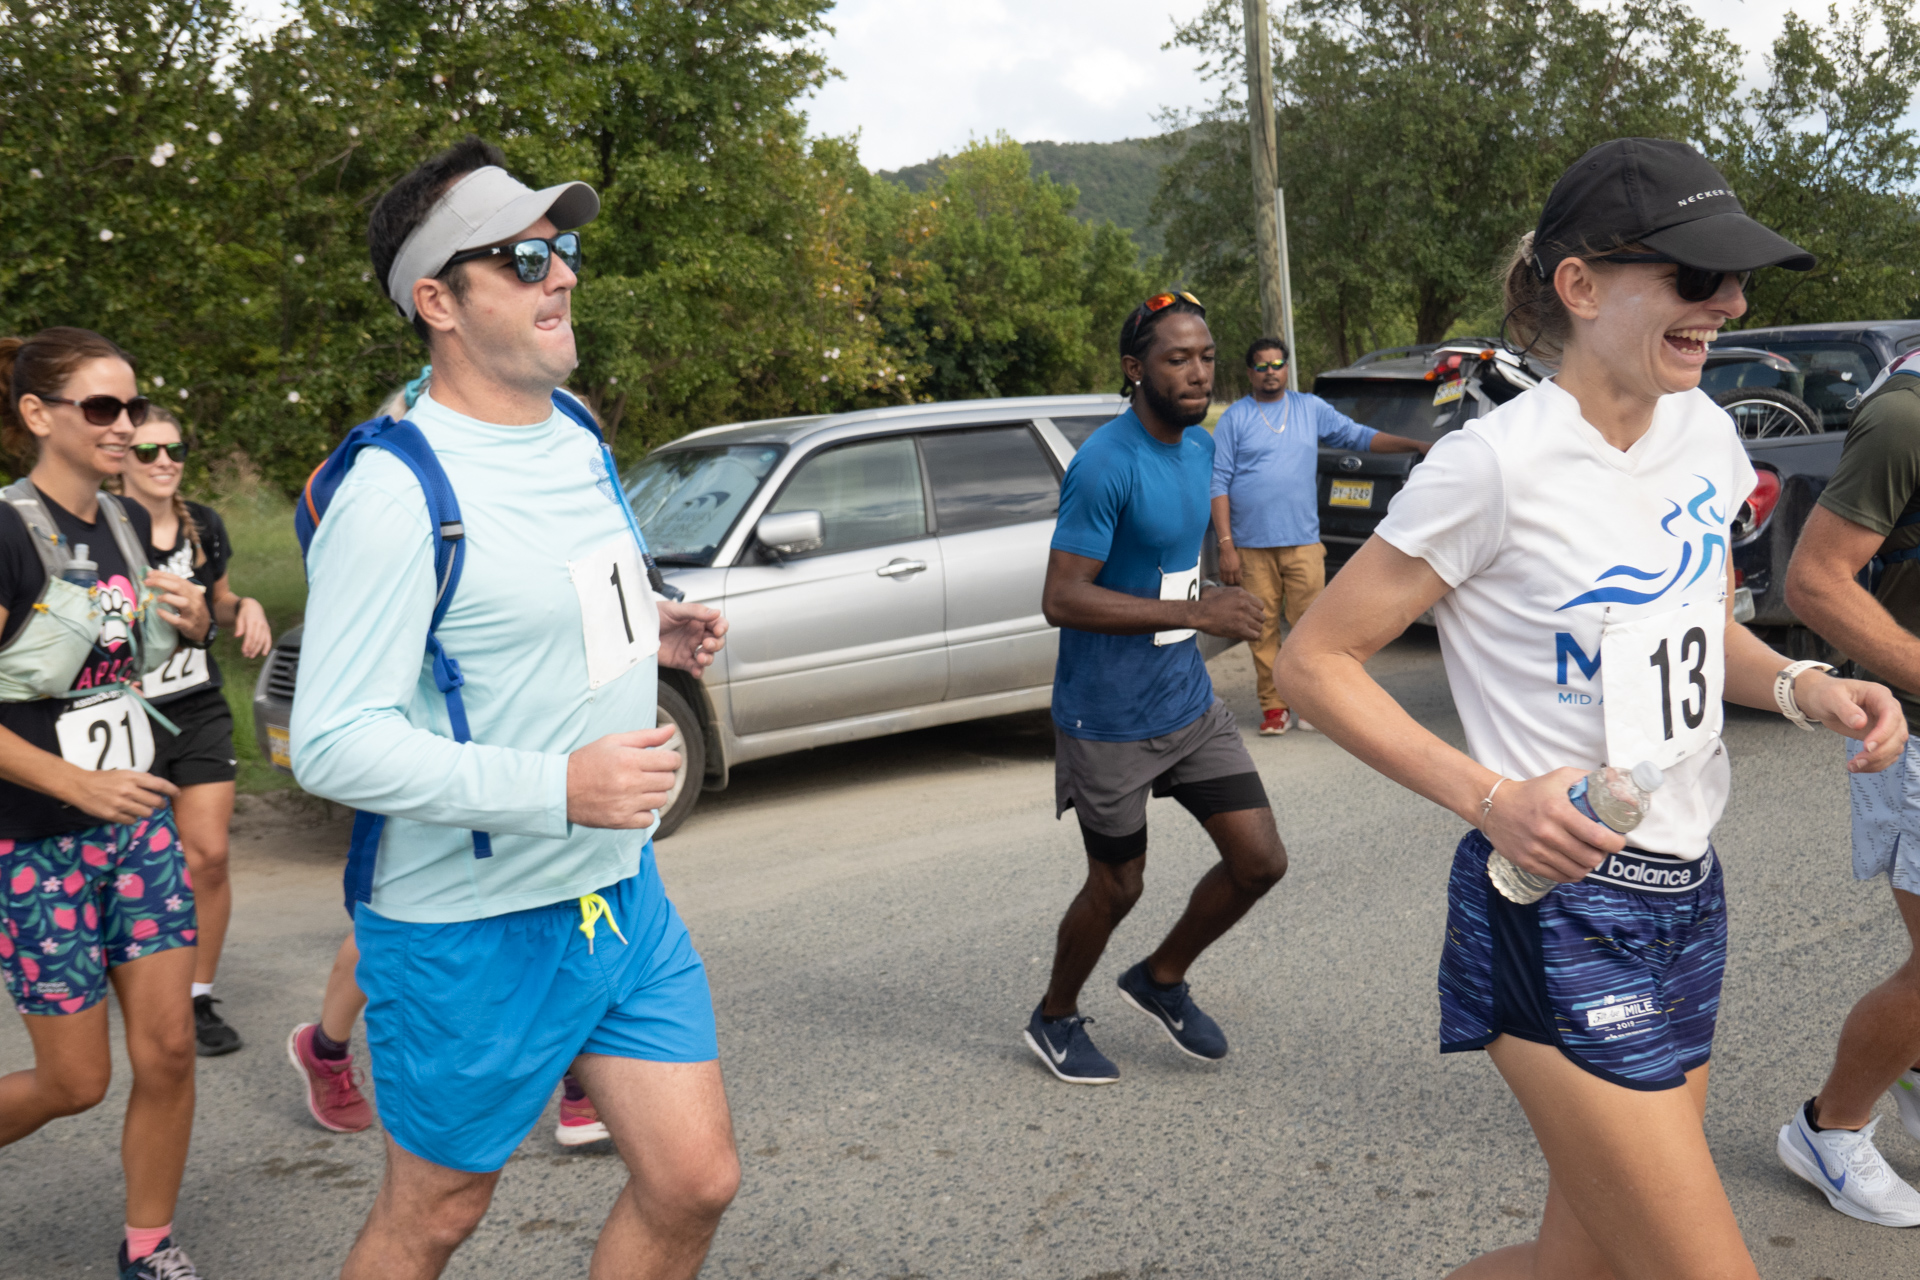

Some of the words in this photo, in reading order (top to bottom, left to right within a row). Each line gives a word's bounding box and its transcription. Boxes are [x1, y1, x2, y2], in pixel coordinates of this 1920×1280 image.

[1678, 189, 1725, 207] NECKER
[610, 562, 634, 644] 1
[1650, 626, 1706, 741] 13
[1558, 692, 1592, 705] MID
[88, 711, 135, 771] 21
[1607, 855, 1691, 886] balance
[1624, 1001, 1654, 1017] MILE
[1616, 1021, 1635, 1030] 2019
